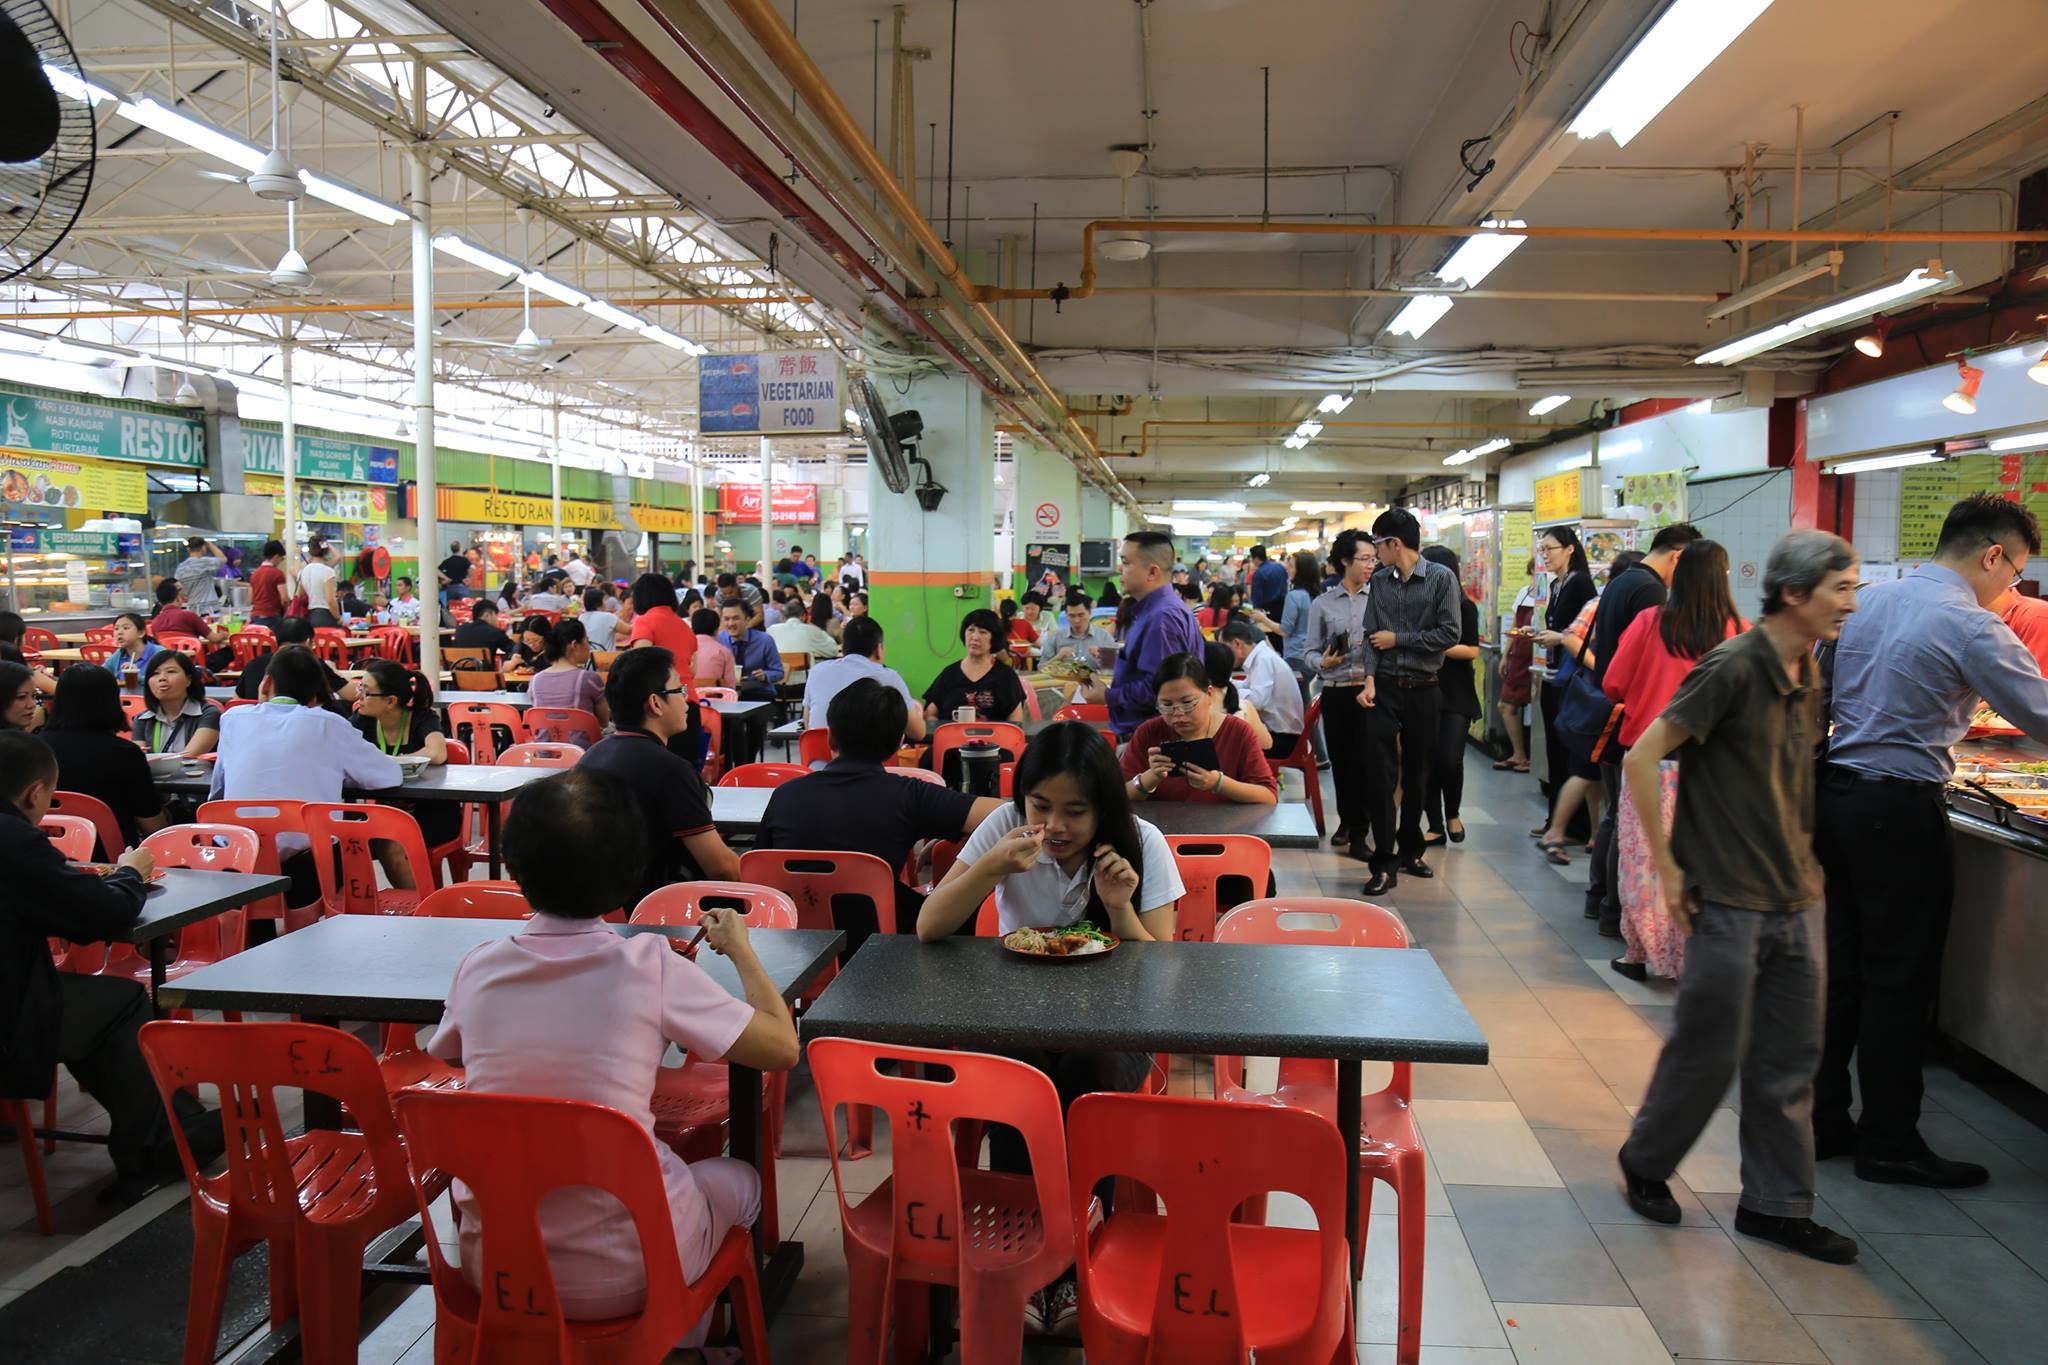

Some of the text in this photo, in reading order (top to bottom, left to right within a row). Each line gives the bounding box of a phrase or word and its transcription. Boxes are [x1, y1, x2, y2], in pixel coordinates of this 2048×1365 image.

[761, 381, 834, 401] VEGETARIAN
[46, 415, 66, 427] NASI
[783, 408, 815, 426] FOOD
[51, 428, 72, 440] ROTI
[51, 441, 99, 455] MURTABAK
[484, 499, 552, 520] RESTORAN
